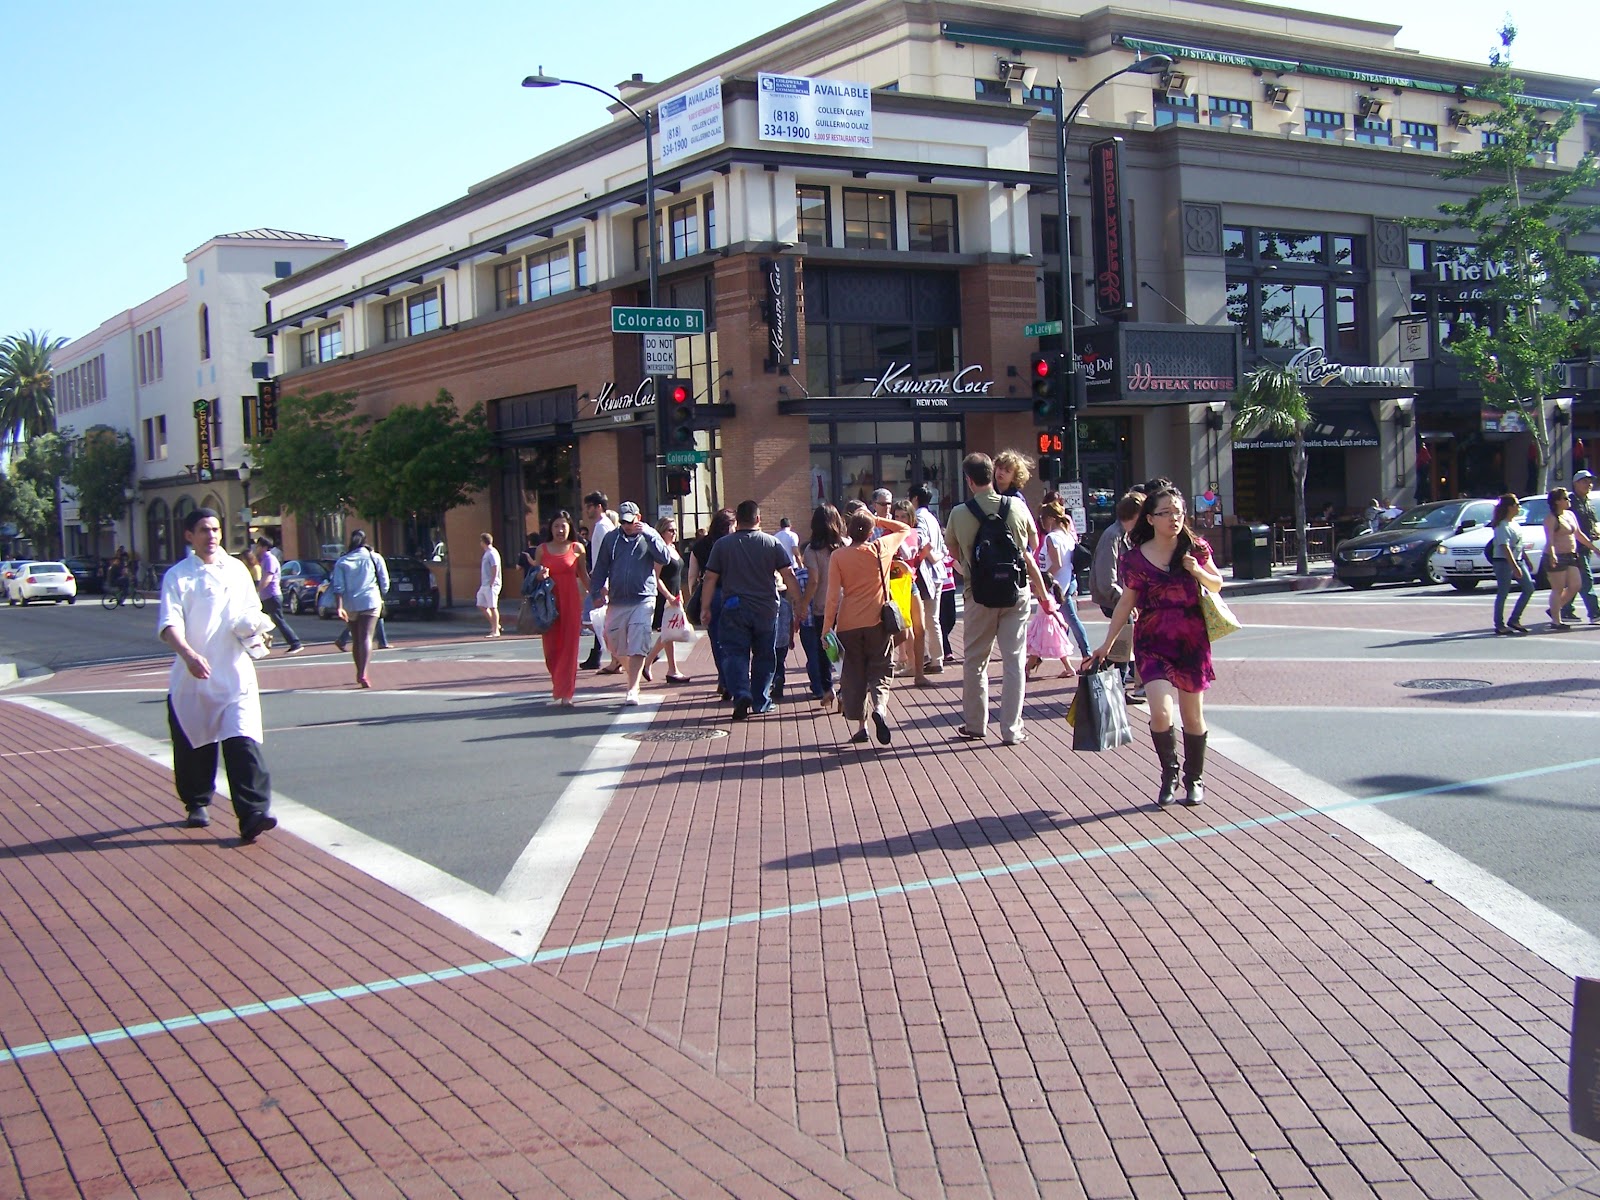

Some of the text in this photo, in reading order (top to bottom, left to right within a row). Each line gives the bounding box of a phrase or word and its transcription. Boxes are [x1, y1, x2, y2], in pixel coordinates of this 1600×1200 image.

[1180, 48, 1246, 65] JJ STEAK HOUSE
[1362, 73, 1385, 83] STEAK
[1386, 76, 1409, 87] HOUSE
[688, 84, 720, 107] AVAILABLE
[814, 84, 868, 98] AVAILABLE
[773, 110, 798, 124] (818)
[818, 106, 864, 116] COLLEEN CAREY
[764, 124, 810, 138] 334-1900
[816, 120, 850, 128] GUILLERMO
[667, 126, 680, 141] (818)
[662, 137, 688, 157] 334-1900
[1104, 148, 1116, 209] HOUSE
[1108, 216, 1118, 272] STEAK
[1432, 260, 1480, 282] The
[618, 314, 699, 328] Colorado Bl
[1025, 326, 1033, 336] De
[1035, 324, 1052, 334] Lacey
[646, 339, 672, 348] DO NOT
[646, 352, 674, 362] BLOCK
[1096, 358, 1113, 372] Pot
[1293, 347, 1342, 384] Pain
[1344, 366, 1411, 386] QUOTIDIEN
[1150, 380, 1190, 390] STEAK
[1194, 380, 1234, 390] HOUSE
[916, 398, 930, 406] NEW
[1234, 442, 1250, 450] Bakery
[668, 454, 696, 462] Colorado
